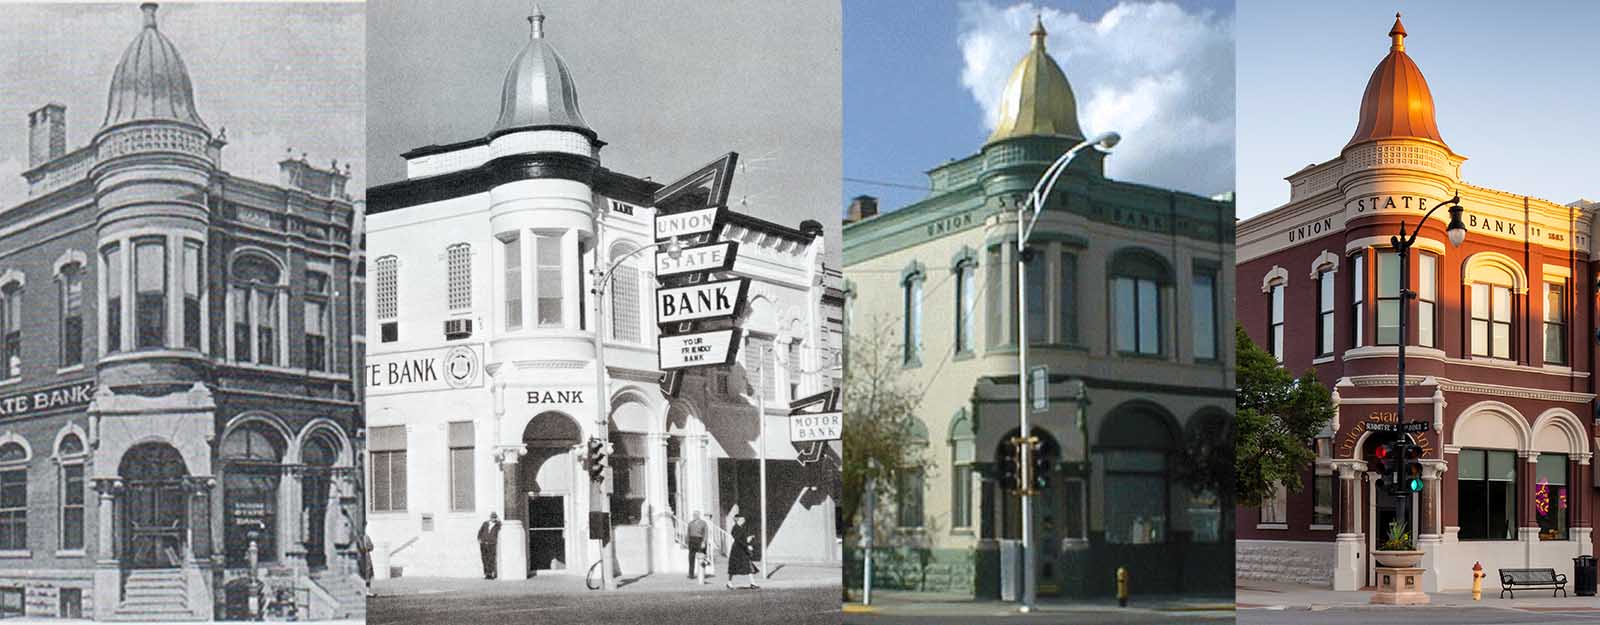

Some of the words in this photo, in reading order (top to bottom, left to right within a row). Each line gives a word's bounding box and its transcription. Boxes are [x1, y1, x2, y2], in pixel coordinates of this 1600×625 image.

[613, 201, 634, 216] BANK
[1289, 218, 1333, 243] UNION
[1358, 195, 1427, 213] STATE
[1470, 215, 1518, 236] BANK
[658, 212, 714, 234] UNION
[928, 214, 972, 236] UNION
[661, 250, 721, 270] STATE
[662, 287, 731, 317] BANK
[683, 337, 703, 345] YOUR
[684, 354, 704, 362] BANK
[388, 358, 437, 385] BANK
[33, 384, 91, 409] BANK
[527, 391, 584, 404] BANK
[795, 415, 838, 427] MOTOR
[799, 427, 836, 438] BANK
[1340, 420, 1366, 458] Union
[1369, 410, 1399, 423] Stat
